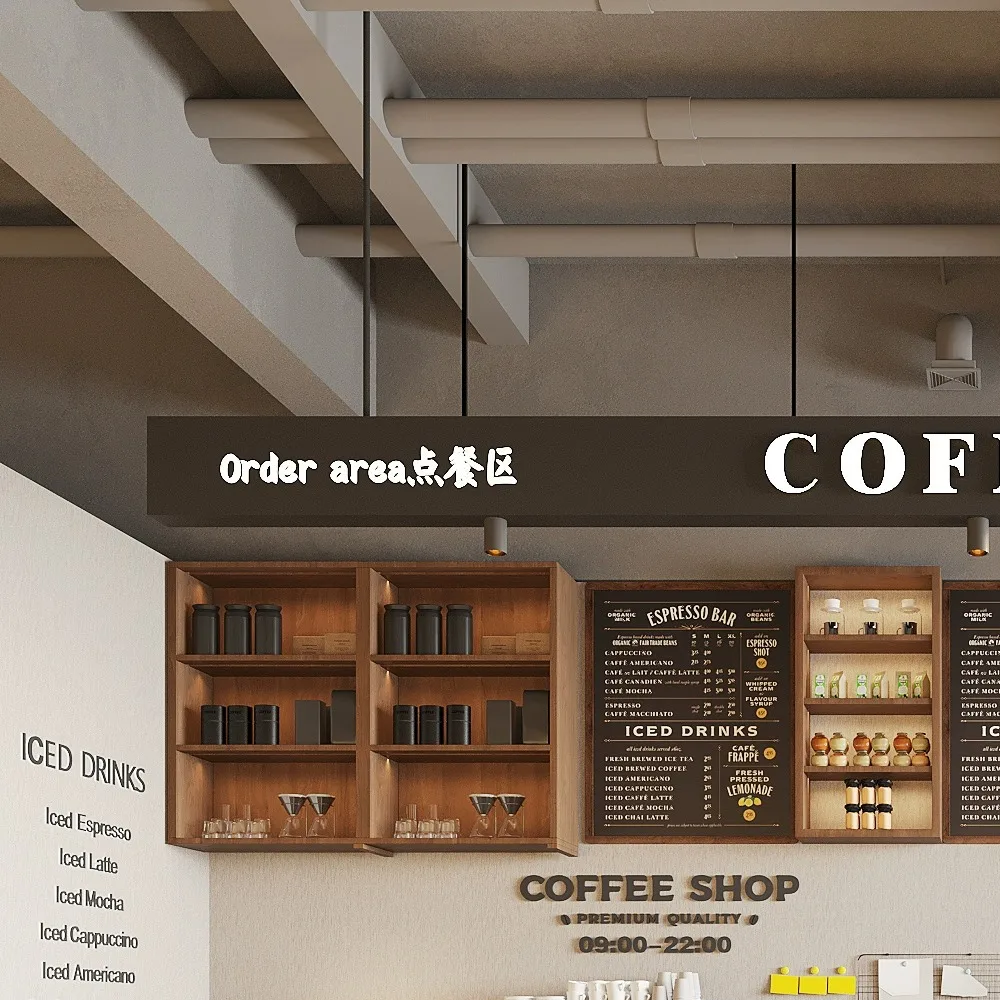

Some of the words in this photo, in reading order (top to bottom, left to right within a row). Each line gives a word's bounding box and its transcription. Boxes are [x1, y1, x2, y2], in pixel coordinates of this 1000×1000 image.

[220, 452, 317, 485] Order
[646, 605, 707, 627] ESPRESSO
[711, 608, 737, 627] BAR
[746, 639, 777, 647] ESPRESSO
[753, 648, 770, 656] SHOT
[625, 726, 673, 737] ICED
[682, 726, 758, 737] DRINKS
[22, 732, 73, 772] ICED
[82, 751, 146, 793] DRINKS
[727, 784, 774, 797] LEMONADE
[47, 807, 72, 829] Iced
[78, 814, 131, 841] Espresso
[60, 848, 85, 868] Iced
[90, 853, 118, 874] Latte
[57, 886, 82, 905] Iced
[86, 890, 124, 911] Mocha
[520, 875, 674, 901] COFFEE
[690, 875, 799, 901] SHOP
[577, 914, 659, 925] PREMIUM
[667, 913, 742, 926] QUALITY
[41, 923, 67, 941] Iced
[70, 926, 138, 948] Cappuccino
[43, 962, 69, 980] Iced
[73, 964, 135, 983] Americano
